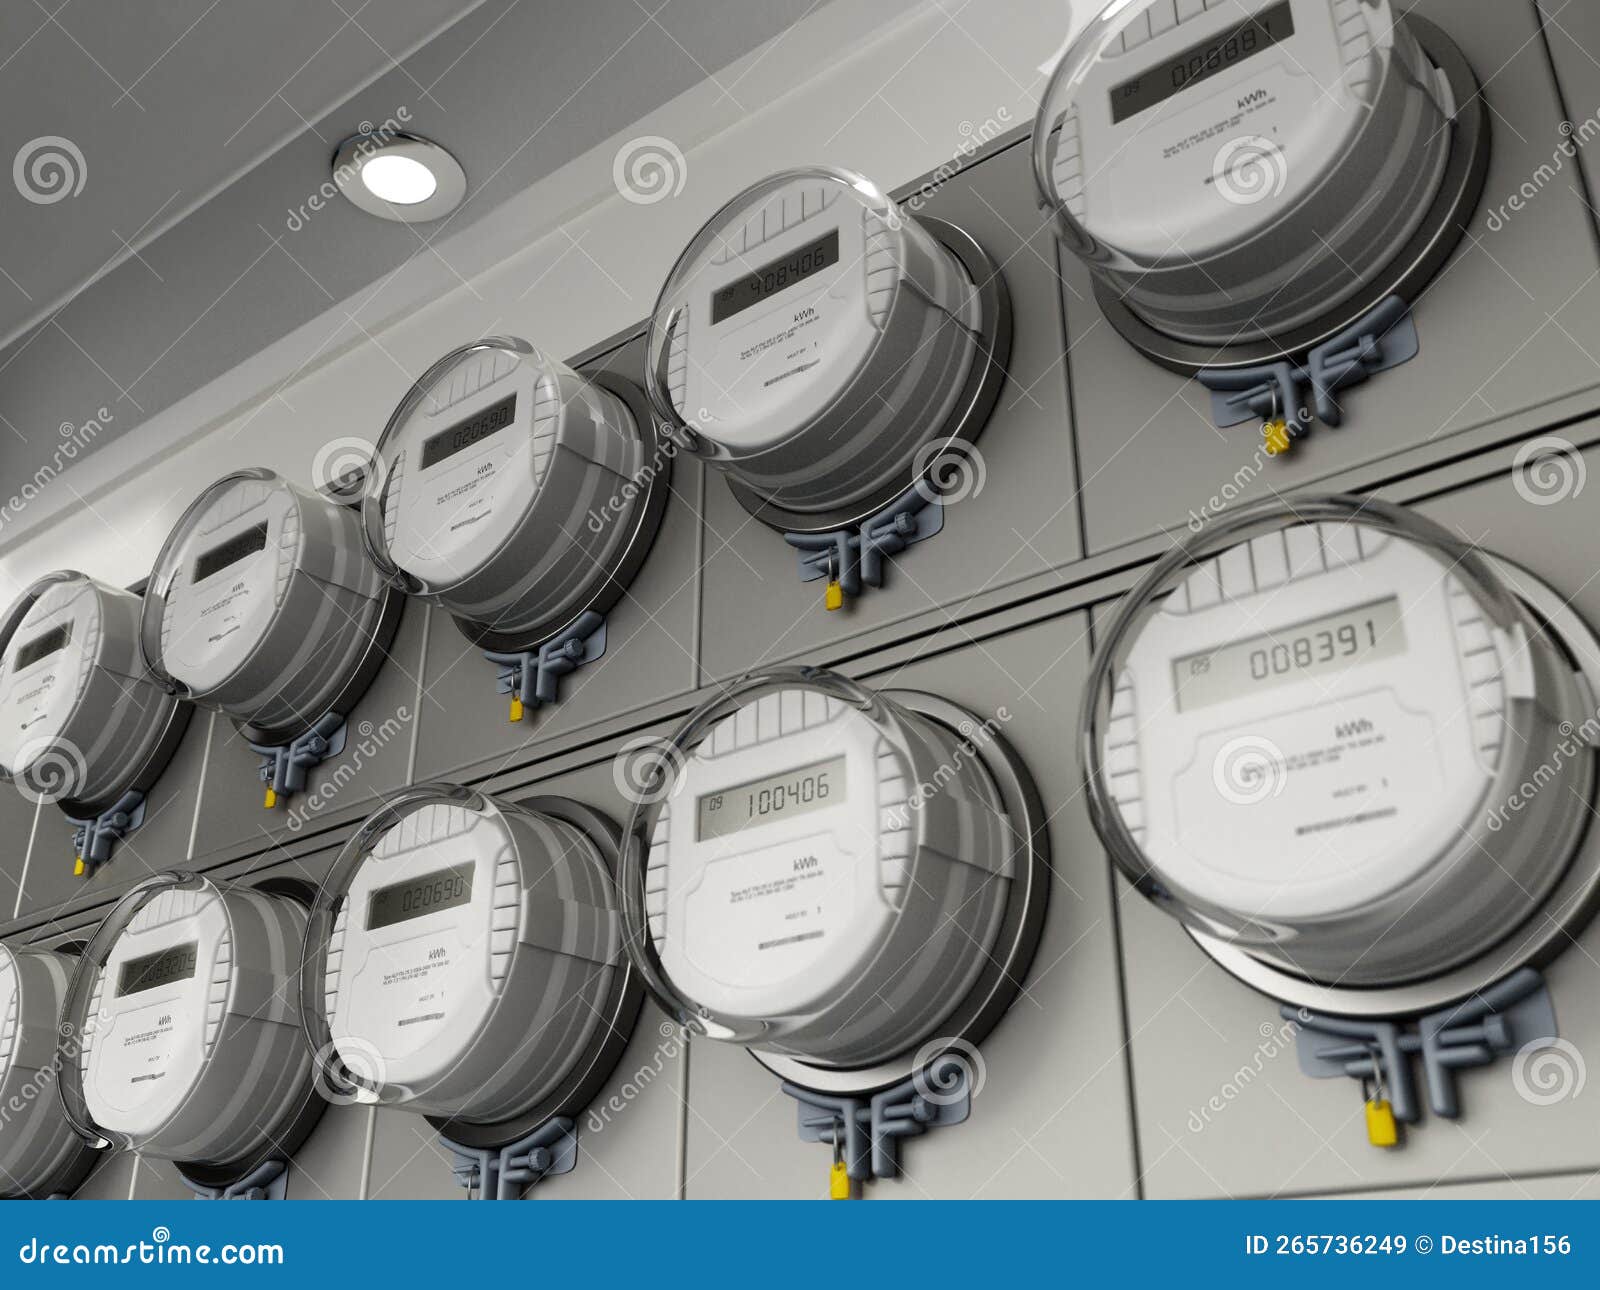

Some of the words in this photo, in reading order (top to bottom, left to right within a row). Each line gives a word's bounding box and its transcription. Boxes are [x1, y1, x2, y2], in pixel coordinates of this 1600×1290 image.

[1236, 88, 1268, 109] kWh
[750, 246, 825, 297] 408406
[793, 306, 815, 322] kWh
[476, 462, 493, 475] kWh
[1249, 619, 1377, 680] 008391
[1335, 718, 1374, 740] kWh
[708, 791, 723, 812] 09
[749, 773, 830, 818] 100406
[793, 856, 818, 871] kWh
[402, 875, 464, 913] 020690
[428, 947, 447, 961] kWh
